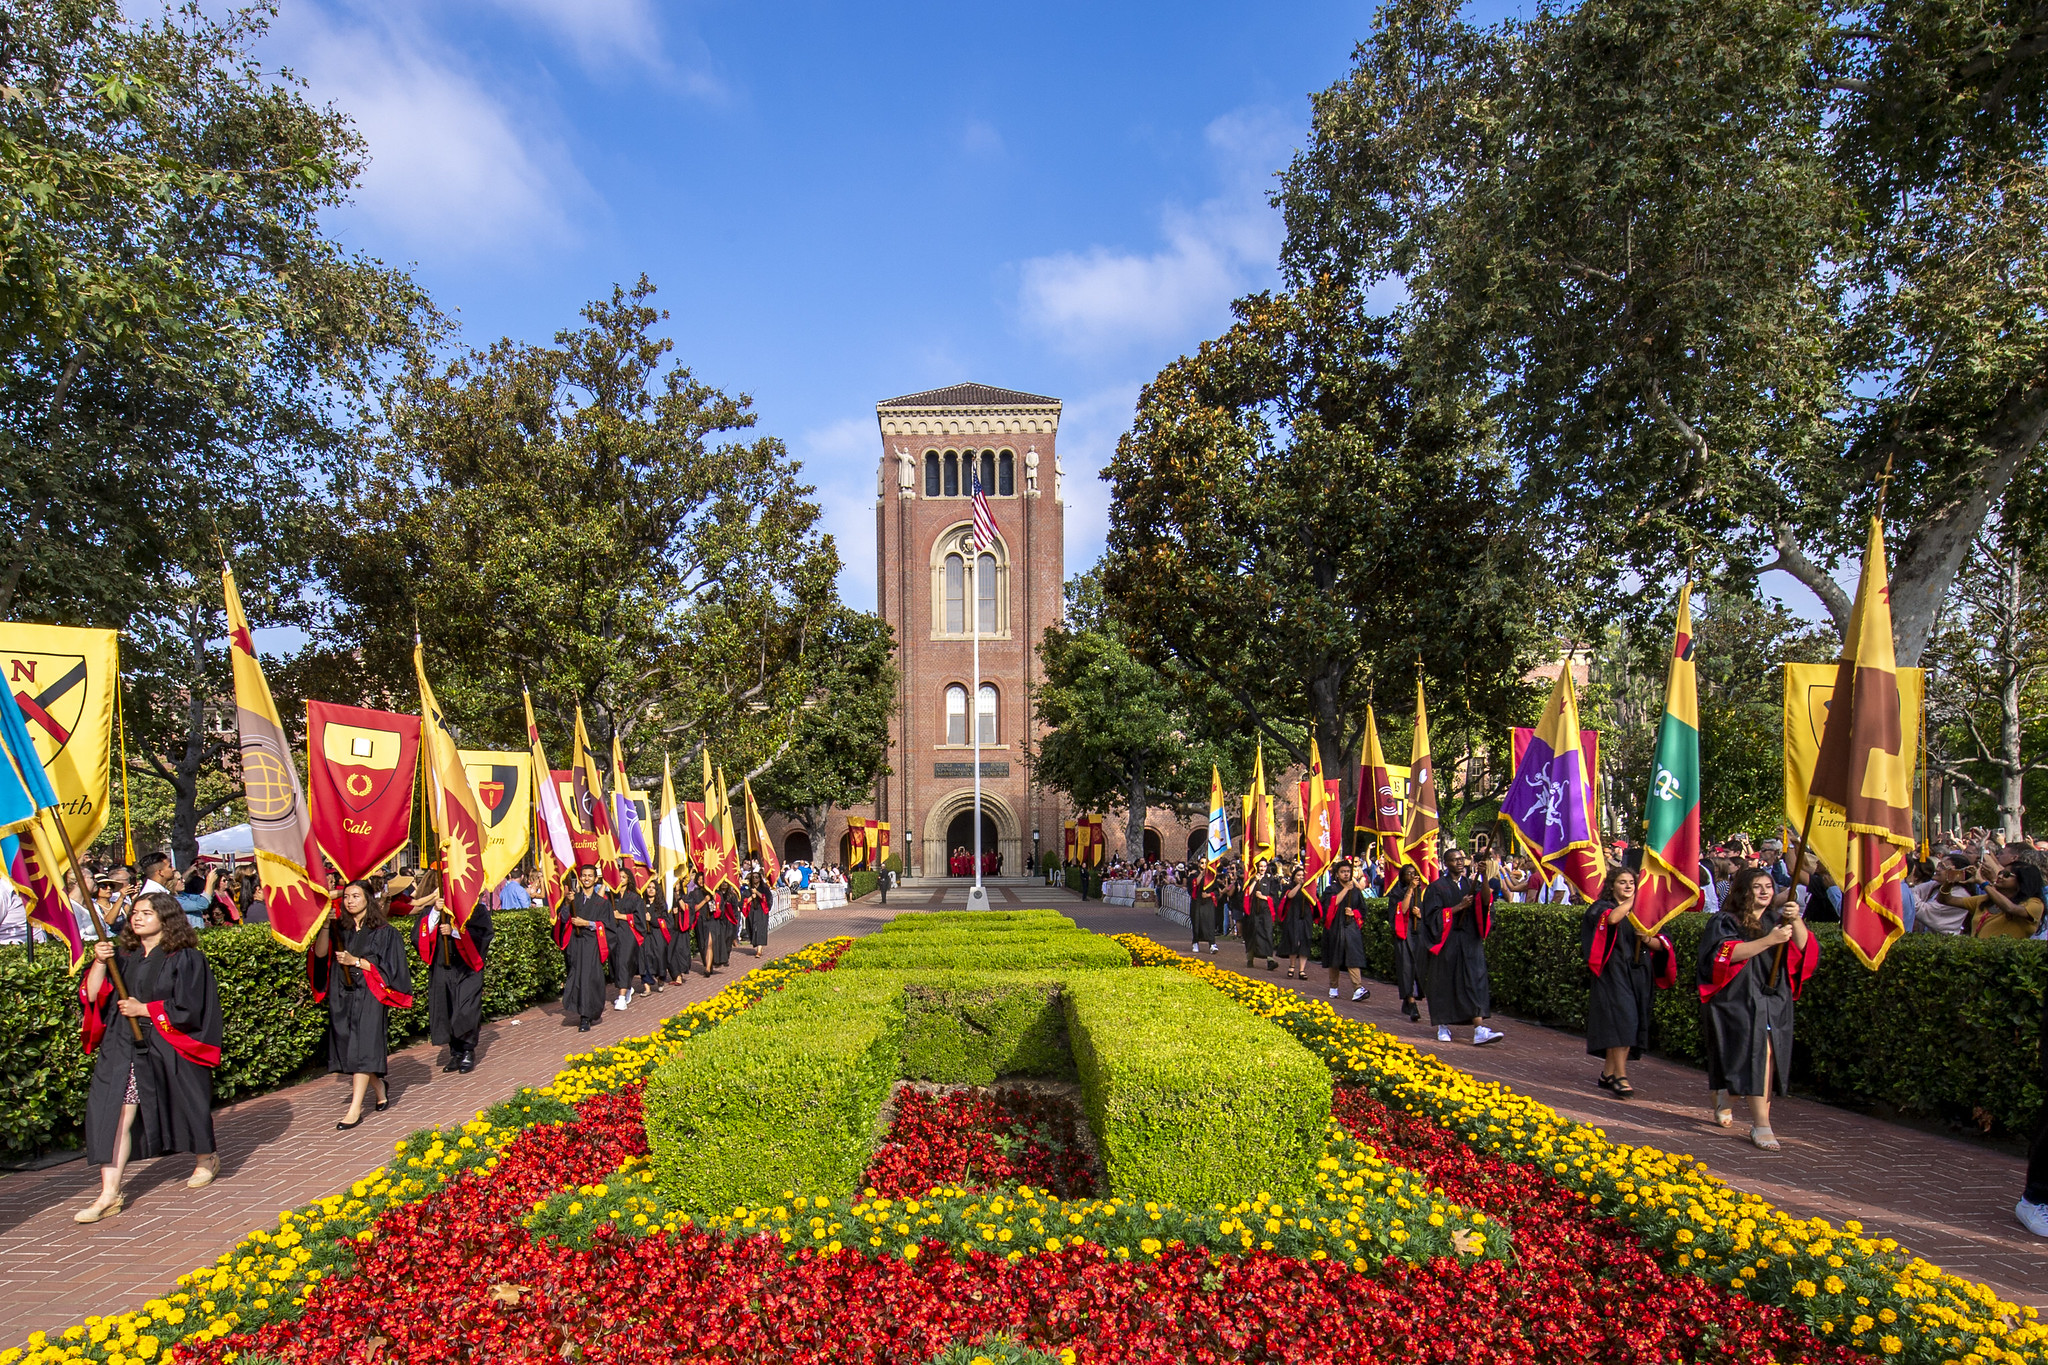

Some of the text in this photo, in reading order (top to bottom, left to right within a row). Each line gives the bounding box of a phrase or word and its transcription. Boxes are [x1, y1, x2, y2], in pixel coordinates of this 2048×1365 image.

[11, 659, 38, 683] N
[60, 795, 93, 816] rth
[343, 817, 373, 835] Cale
